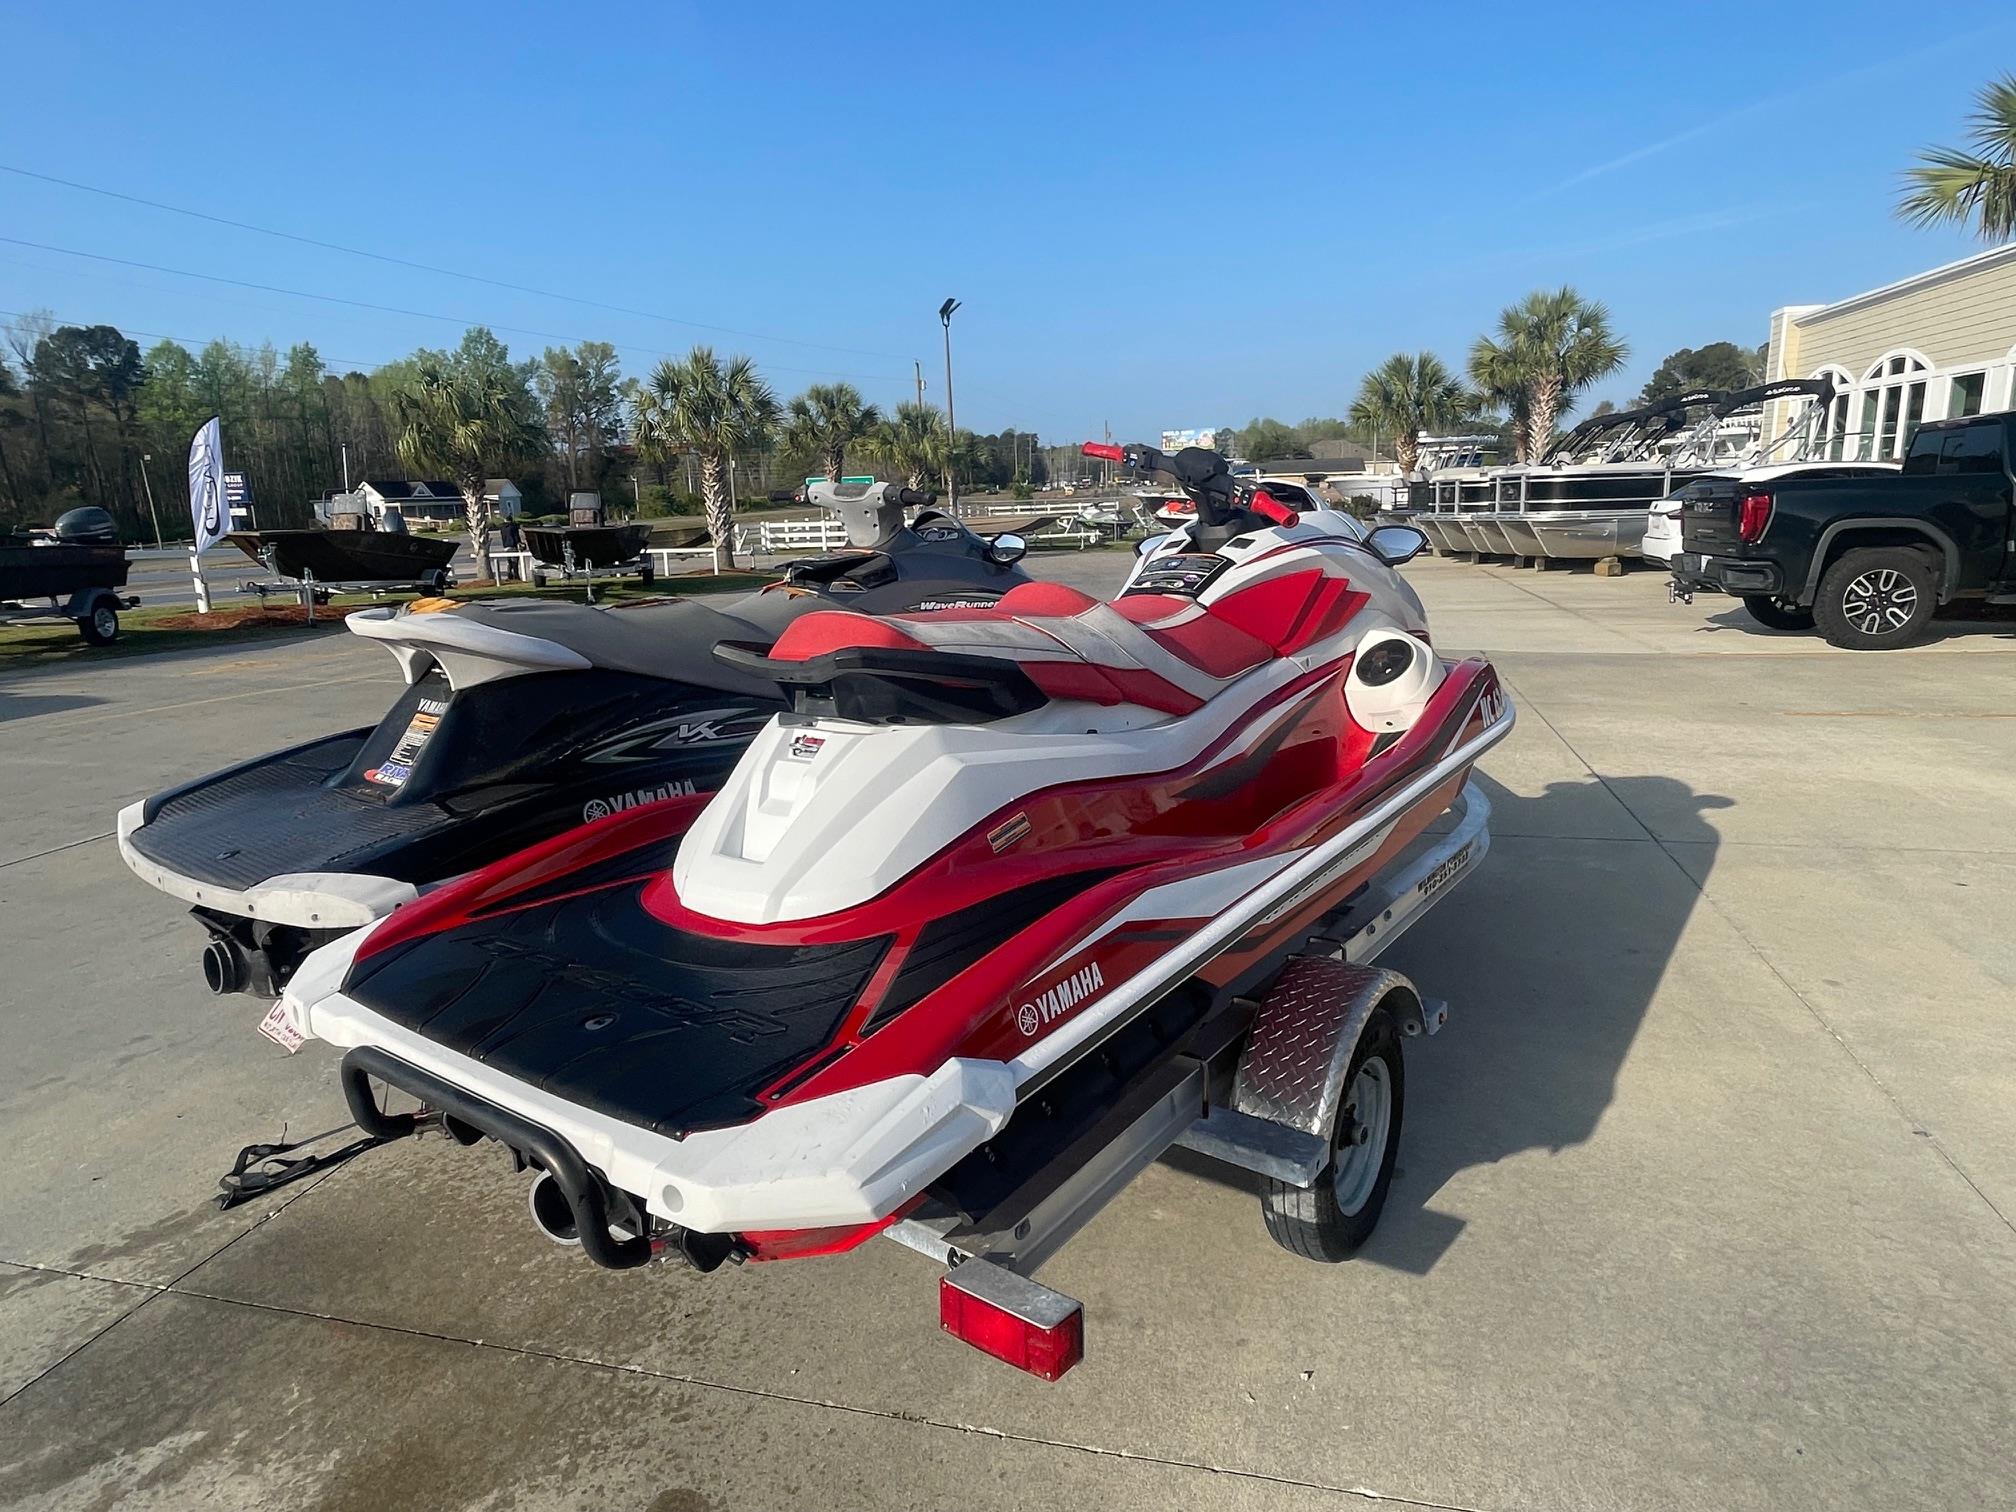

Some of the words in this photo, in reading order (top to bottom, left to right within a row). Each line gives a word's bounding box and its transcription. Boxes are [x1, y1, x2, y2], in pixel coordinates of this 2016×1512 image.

[920, 601, 1000, 610] WaveRunner
[678, 721, 724, 744] VX
[609, 779, 697, 813] YAMAHA
[1035, 961, 1105, 1024] YAMAHA
